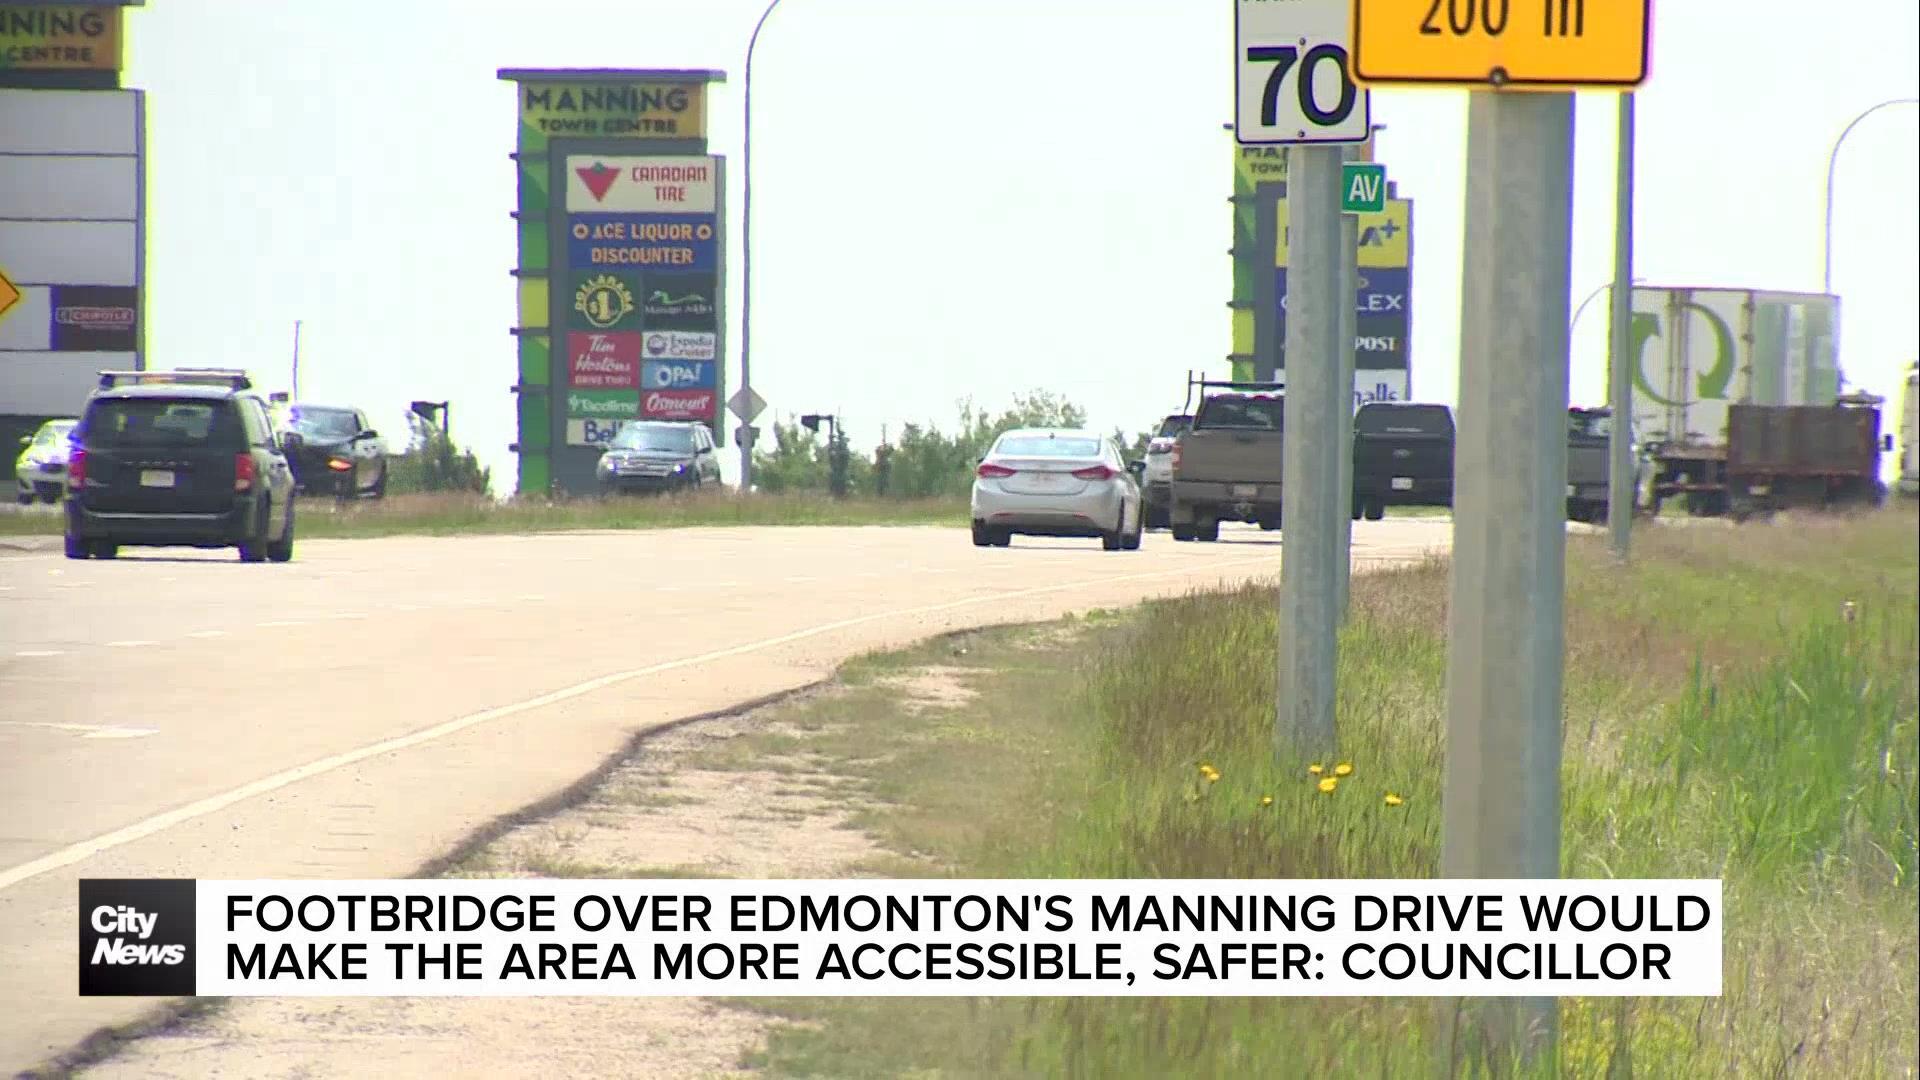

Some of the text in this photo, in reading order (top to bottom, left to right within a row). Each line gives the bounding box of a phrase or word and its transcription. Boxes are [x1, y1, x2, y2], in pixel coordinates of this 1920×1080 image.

[1420, 0, 1508, 35] 200
[1247, 44, 1357, 127] 70
[526, 87, 689, 112] MANNING
[539, 118, 678, 133] TOWN CENTRE
[631, 166, 708, 182] CANADIAN
[1250, 162, 1288, 174] TOW
[654, 186, 686, 202] TIRE
[1348, 173, 1380, 202] AV
[593, 223, 693, 242] ACE LIQUOR
[591, 247, 694, 264] DISCOUNTER
[588, 334, 616, 353] Tim
[1354, 336, 1396, 352] POST
[575, 353, 632, 372] Hortons
